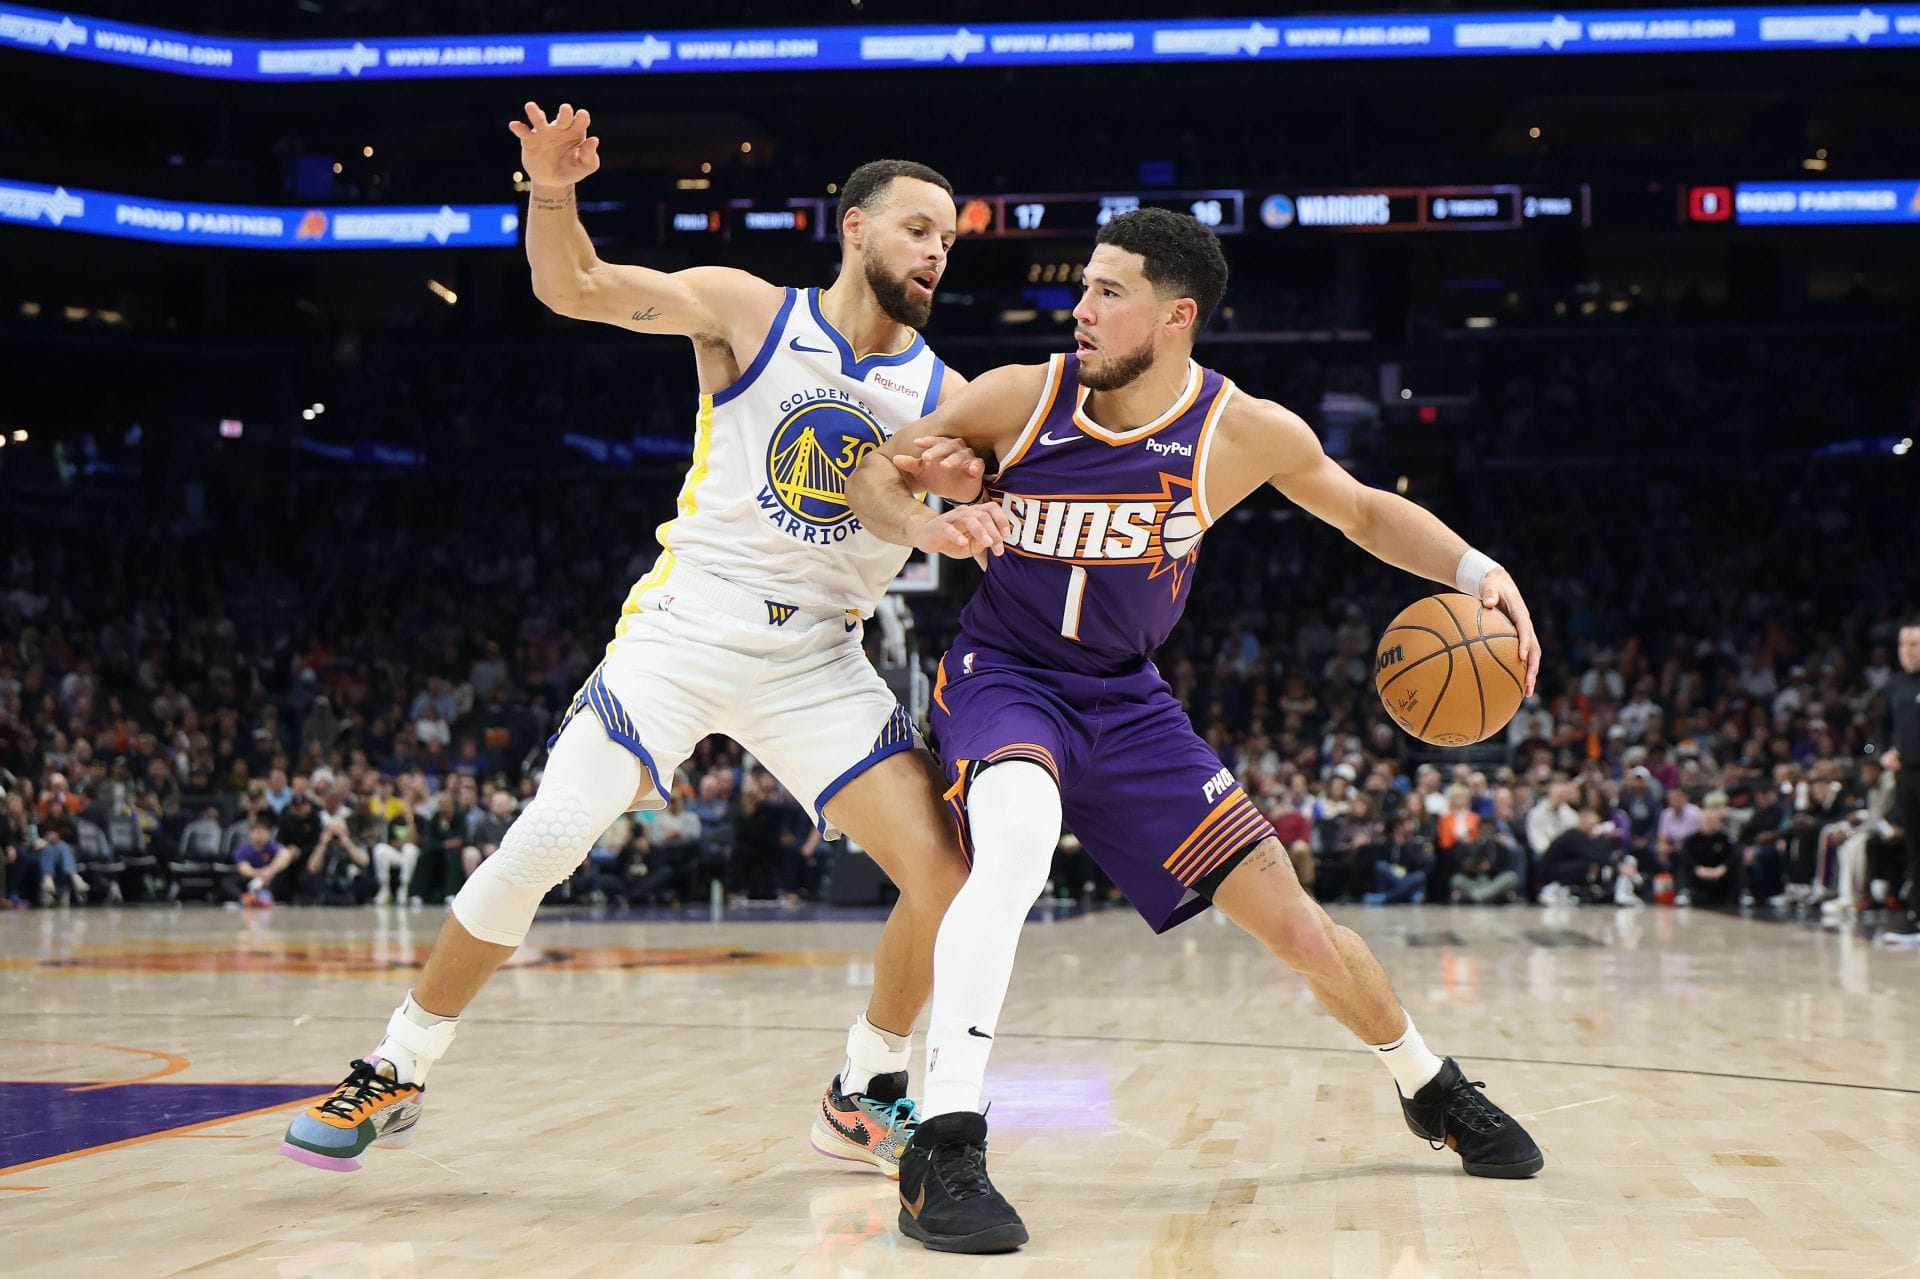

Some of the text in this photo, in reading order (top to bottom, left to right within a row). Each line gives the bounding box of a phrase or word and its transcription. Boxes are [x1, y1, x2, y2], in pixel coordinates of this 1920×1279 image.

[1296, 194, 1390, 226] WARRIORS
[1799, 190, 1897, 211] PARTNER
[116, 204, 284, 237] PROUD PARTNER
[1015, 204, 1045, 229] 17
[874, 372, 919, 399] Rakuten
[780, 388, 849, 413] GOLDEN
[1145, 437, 1193, 457] PayPal
[756, 484, 863, 545] WARRIOR
[1000, 492, 1157, 558] SUNS
[1061, 565, 1088, 641] 1
